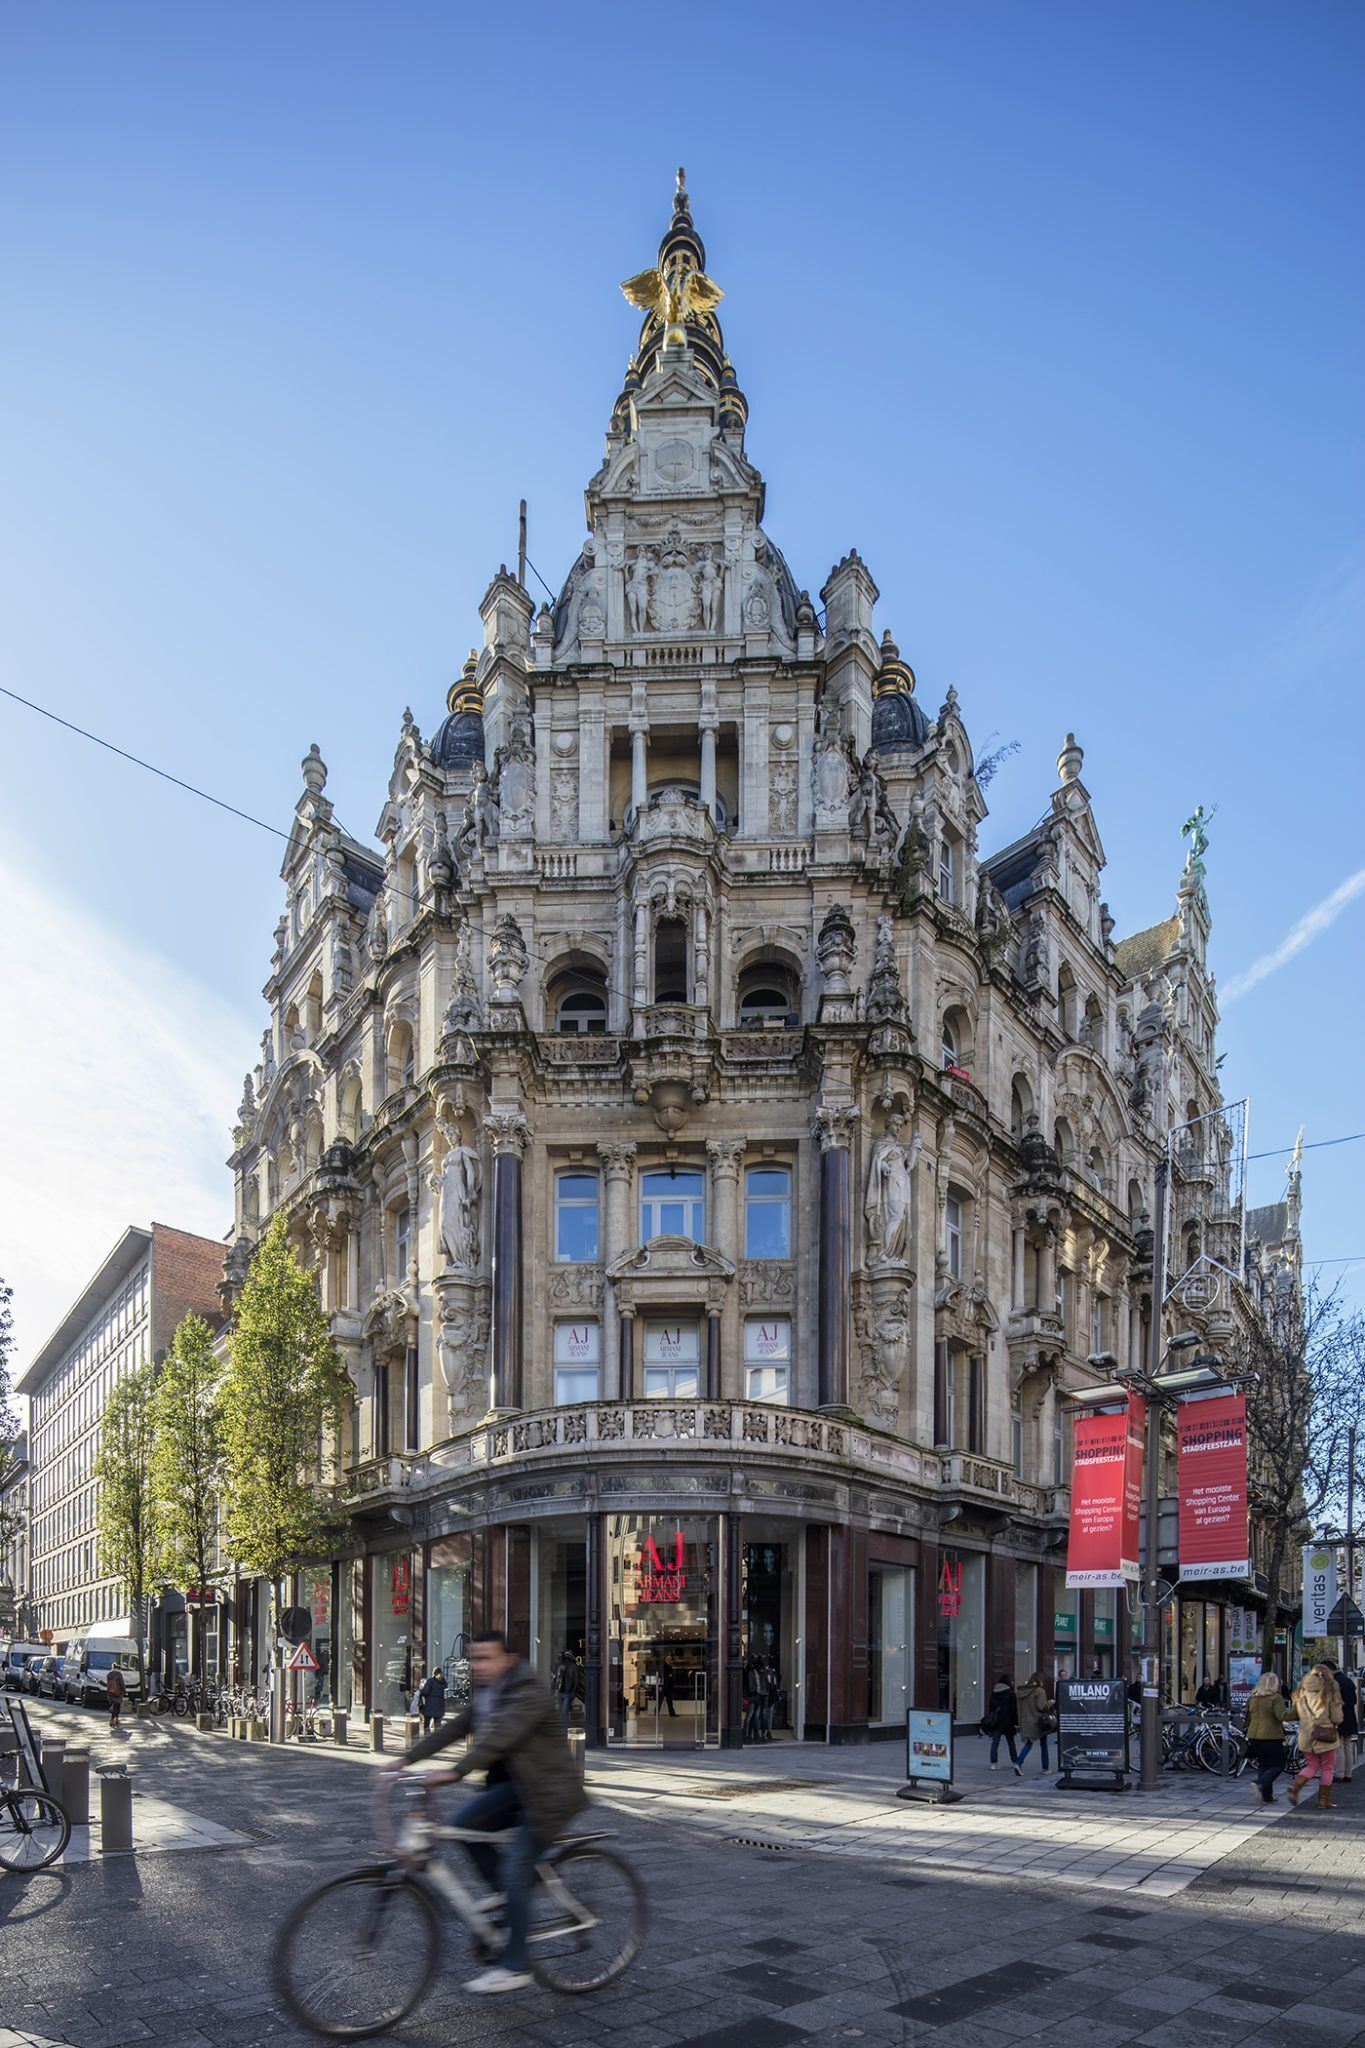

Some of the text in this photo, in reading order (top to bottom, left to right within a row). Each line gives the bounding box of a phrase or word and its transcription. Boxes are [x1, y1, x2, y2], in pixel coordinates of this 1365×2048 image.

[568, 1327, 589, 1344] AJ
[659, 1328, 681, 1345] AJ
[756, 1324, 779, 1341] AJ
[1182, 1428, 1242, 1446] SHOPPING
[1182, 1439, 1243, 1453] STADSFEESTZAAL
[1205, 1485, 1232, 1494] mooiste
[1092, 1496, 1117, 1504] mooiste
[1185, 1494, 1240, 1506] Shopping Center
[1075, 1507, 1102, 1515] Shopping
[1207, 1505, 1231, 1514] Europa
[1093, 1515, 1114, 1523] Europa
[1204, 1514, 1230, 1525] gezien?
[1089, 1524, 1112, 1534] gezien?
[633, 1532, 687, 1571] AJ
[938, 1561, 963, 1592] AJ
[1183, 1565, 1245, 1576] meir-as.be
[635, 1575, 687, 1588] ARMANI
[640, 1589, 681, 1602] JEANS
[1311, 1574, 1326, 1625] veritas
[1232, 1606, 1240, 1638] veritas
[1069, 1684, 1110, 1697] MILANO
